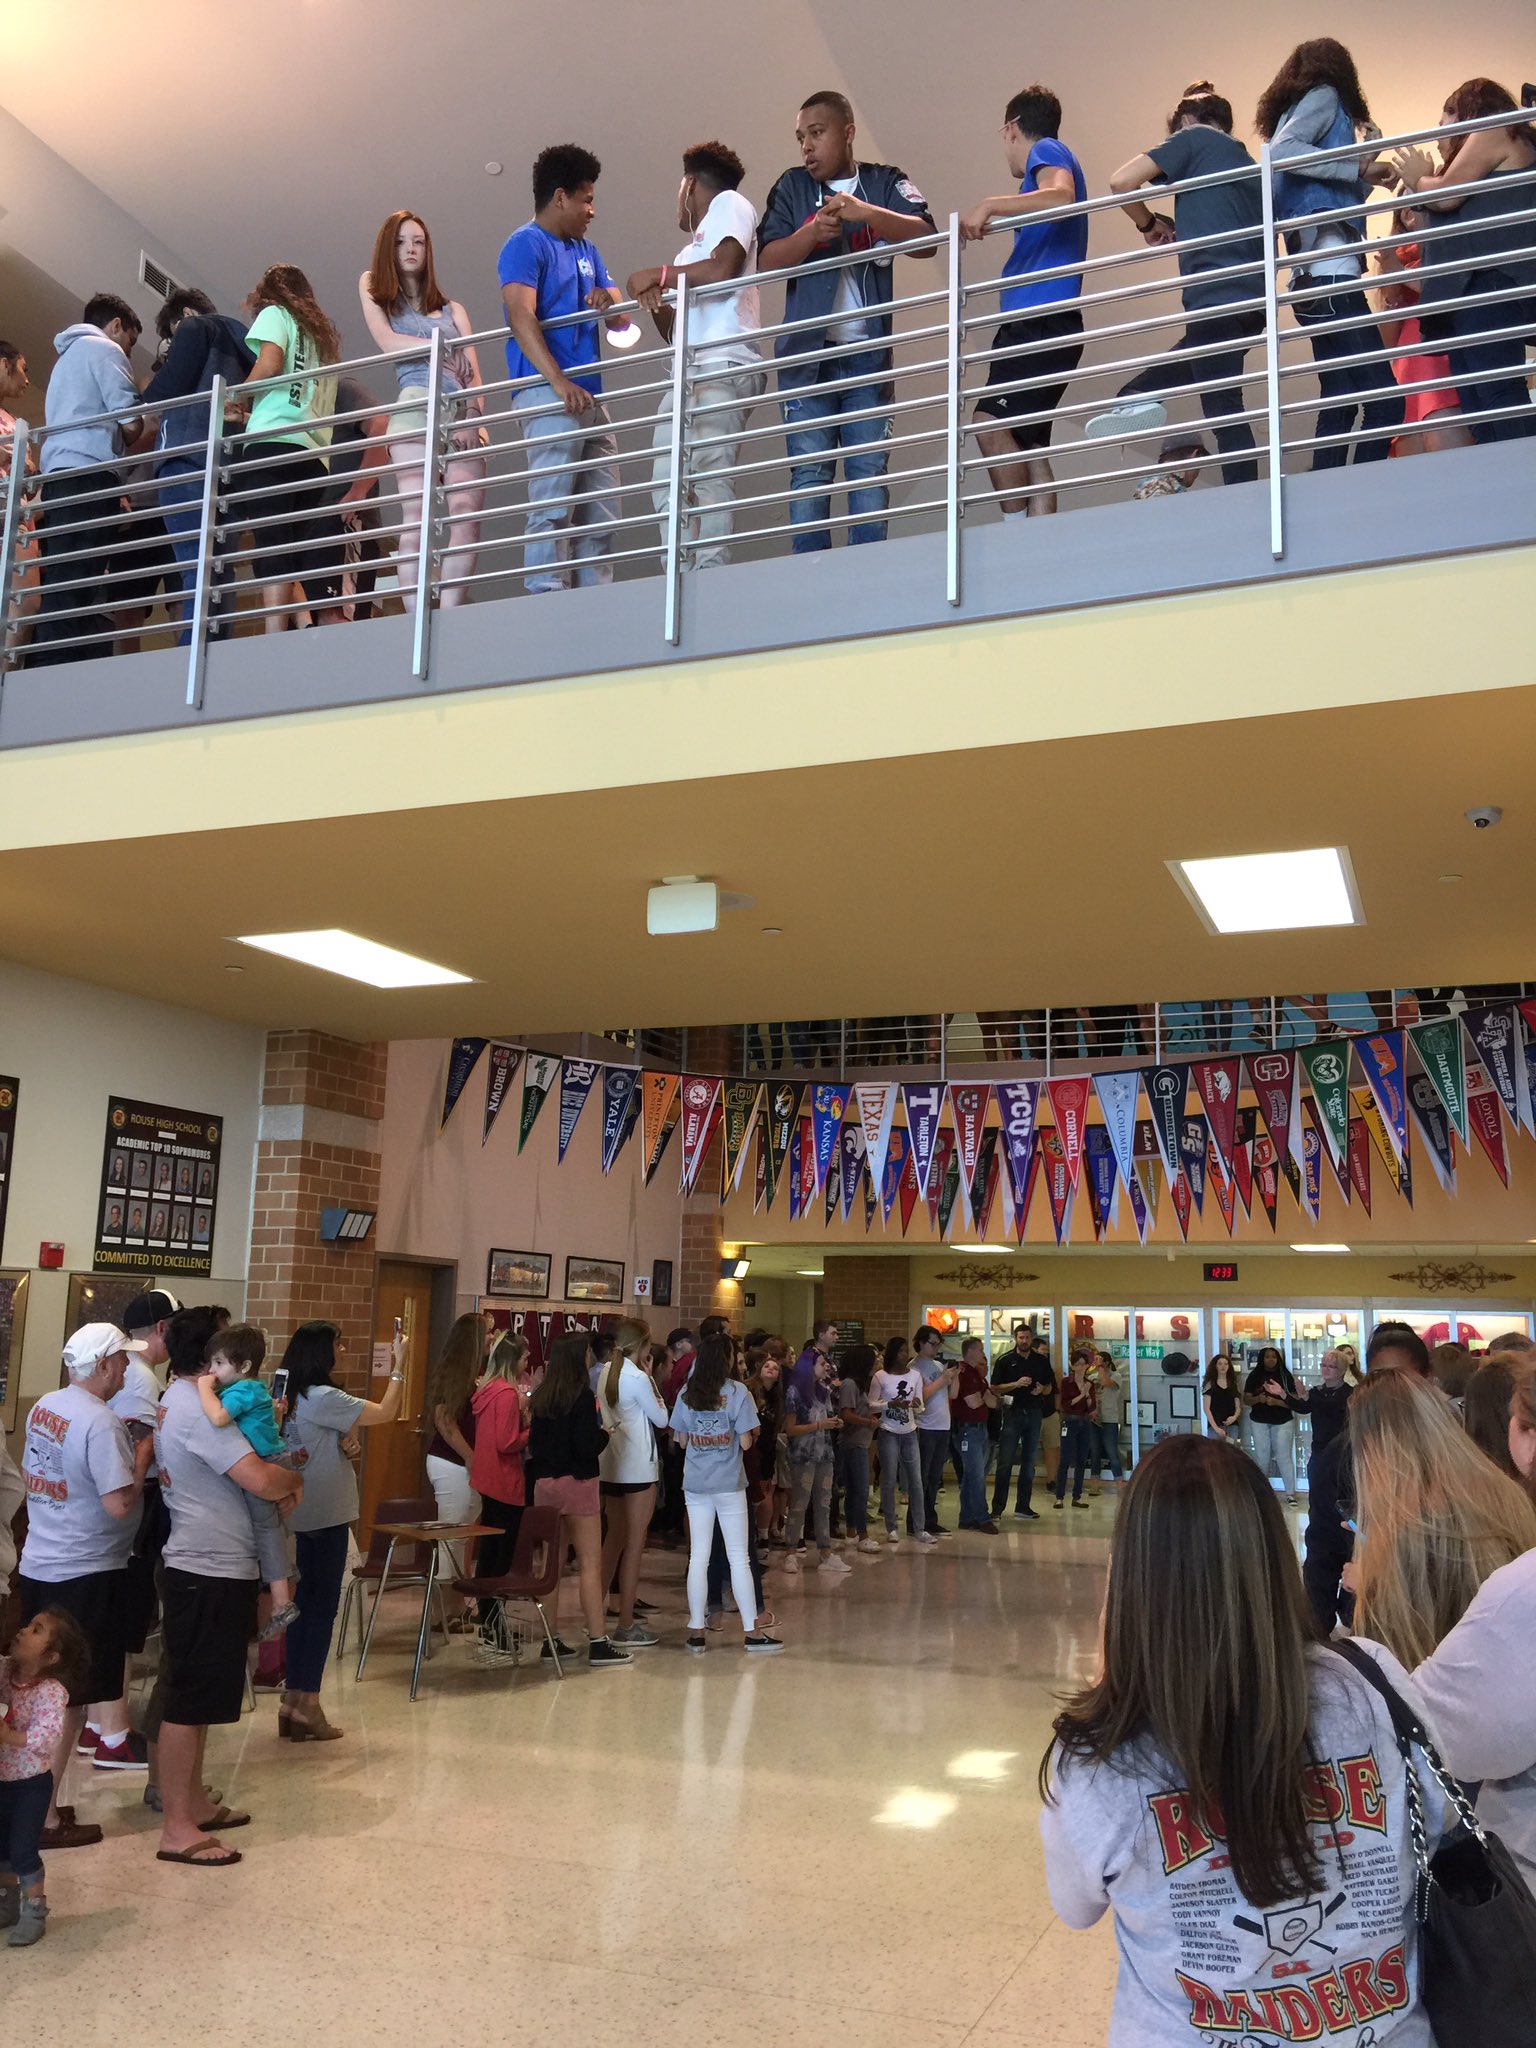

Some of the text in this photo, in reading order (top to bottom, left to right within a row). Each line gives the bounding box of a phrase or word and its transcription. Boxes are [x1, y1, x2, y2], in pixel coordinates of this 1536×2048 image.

[289, 353, 305, 401] STTE
[1203, 1067, 1214, 1103] RAZORBACKS
[1436, 1053, 1460, 1113] DARTMOUTH
[1492, 1051, 1508, 1098] STATE UNIVERSITY
[1498, 1050, 1507, 1073] STEPHEN
[1504, 1079, 1514, 1098] AUSTIN
[488, 1067, 507, 1112] BROWN
[560, 1090, 586, 1148] RICE UNIVERSITY
[605, 1099, 620, 1137] YALE
[652, 1092, 663, 1139] PRINCETON
[861, 1090, 886, 1141] TEXAS
[1005, 1084, 1032, 1136] TCU
[1327, 1098, 1338, 1119] State
[1332, 1088, 1345, 1126] Colorado
[1480, 1097, 1499, 1138] LOYOLA
[131, 1114, 202, 1135] ROUSE HIGH SCHOOL
[685, 1112, 698, 1147] ALABAMA
[780, 1122, 789, 1149] MIZZOU
[918, 1116, 929, 1156] TARLETON
[1065, 1110, 1078, 1160] CORNELL
[1117, 1110, 1128, 1163] COLUMBIA
[1165, 1098, 1177, 1168] GEORGETOWN
[117, 1136, 211, 1160] ACADEMIC TOP 10 SOPHOMORES
[820, 1120, 832, 1160] KANSAS
[965, 1114, 974, 1166] HARVARD
[1142, 1126, 1152, 1151] ULM
[1382, 1139, 1394, 1167] COWBOYS
[847, 1162, 857, 1195] K-STATE
[1305, 1161, 1314, 1175] SAN
[1358, 1178, 1366, 1191] STATE
[95, 1251, 210, 1269] COMMITTED TO EXCELLENCE
[514, 1314, 524, 1334] P
[540, 1316, 550, 1337] T
[591, 1318, 598, 1332] A
[1075, 1315, 1094, 1338] R
[1171, 1316, 1190, 1340] S
[1121, 1346, 1160, 1360] Raer Way
[1147, 1744, 1387, 1876] RSE
[1358, 1845, 1393, 1858] O'DONNELL
[1367, 1855, 1396, 1868] VASQUEZ
[1198, 1877, 1227, 1888] THOMAS
[1362, 1866, 1398, 1878] SOUTHARD
[1169, 1887, 1234, 1900] COLTON MITCHELL
[1171, 1900, 1205, 1909] JAMESON
[1352, 1890, 1374, 1898] DEVIN
[1352, 1900, 1382, 1908] COOPER
[1173, 1909, 1221, 1919] CODY VANNOY
[1336, 1922, 1359, 1931] ROBBY
[1181, 1930, 1208, 1938] DALTON
[1181, 1940, 1240, 1953] JACKSON GLENN
[1181, 1952, 1241, 1963] GRANT FOREMAN
[1182, 1960, 1235, 1973] DEVIN HOOPER
[1175, 1936, 1410, 2042] RAIDERS
